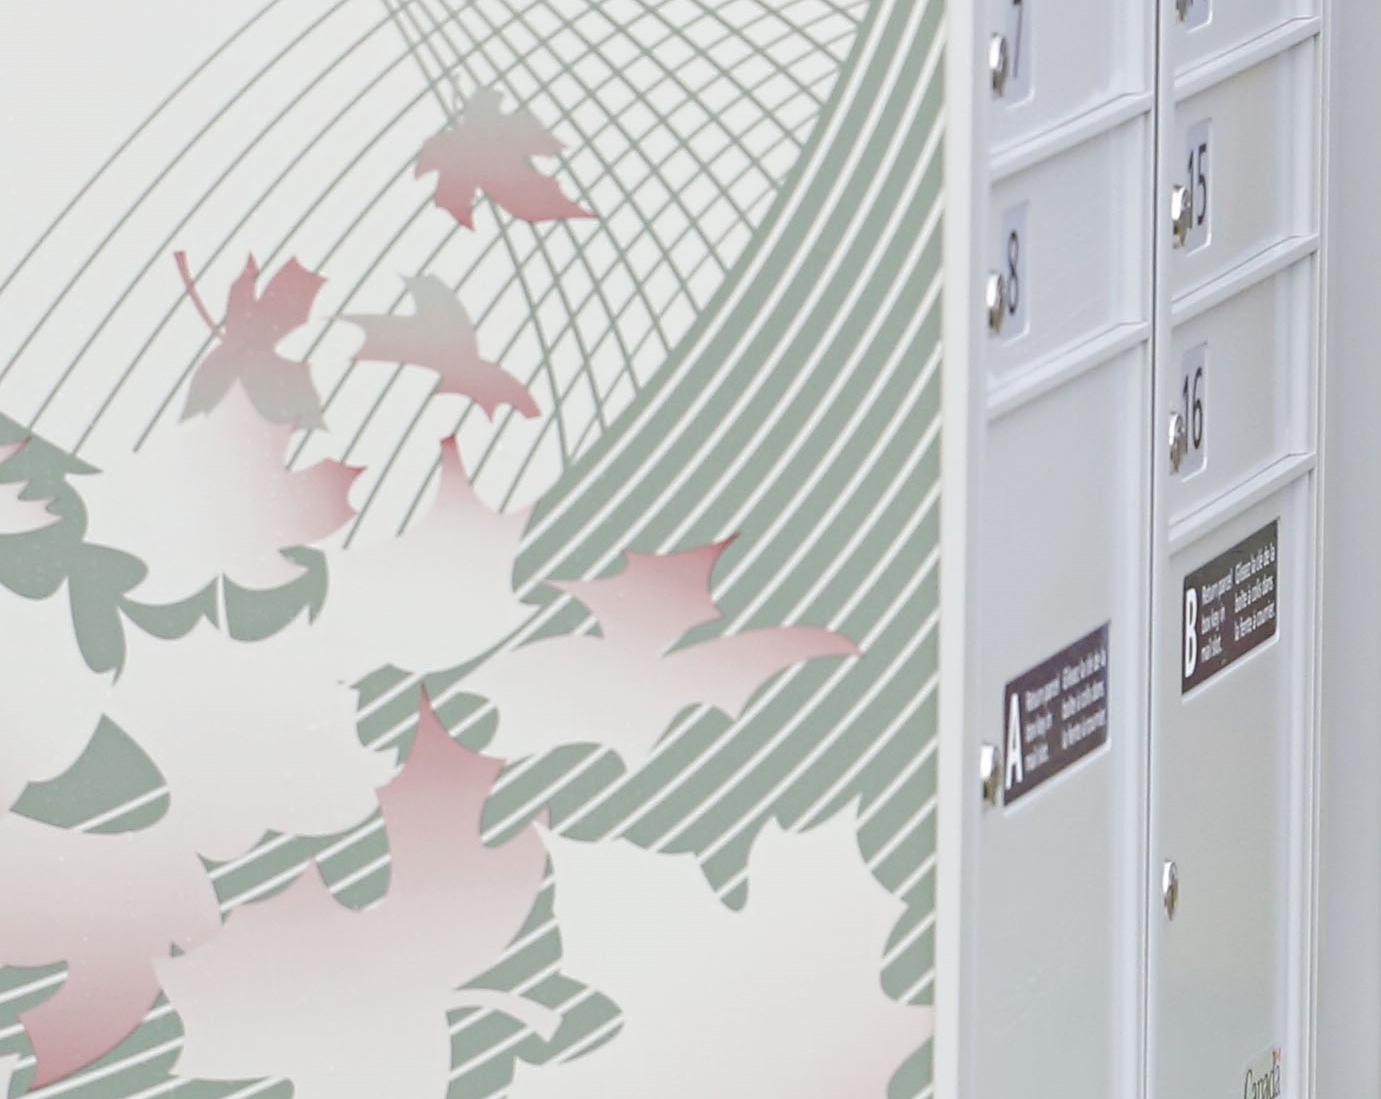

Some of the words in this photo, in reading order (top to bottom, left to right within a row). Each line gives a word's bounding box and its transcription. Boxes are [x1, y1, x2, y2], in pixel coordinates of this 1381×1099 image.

[1187, 142, 1207, 230] 15
[1008, 230, 1019, 315] 8
[1183, 366, 1203, 454] 16
[1185, 587, 1198, 678] B
[1005, 692, 1023, 791] A
